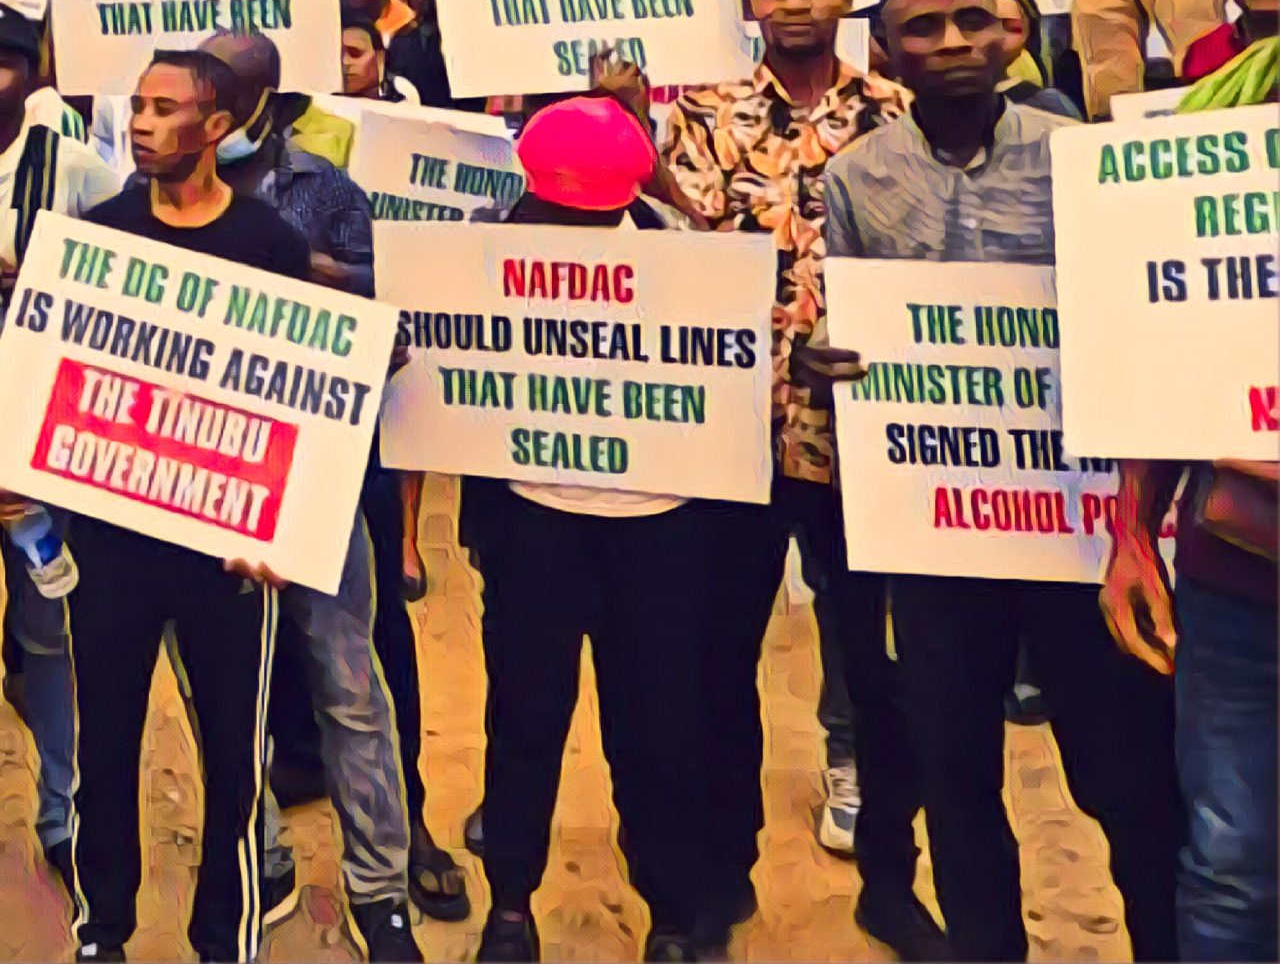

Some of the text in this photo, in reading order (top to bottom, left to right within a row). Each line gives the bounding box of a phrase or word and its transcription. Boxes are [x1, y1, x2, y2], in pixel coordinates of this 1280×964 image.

[97, 2, 152, 35] THAT
[161, 0, 221, 32] HAVE
[410, 152, 451, 189] THE
[1098, 130, 1250, 184] ACCESS
[1194, 192, 1280, 237] REG
[59, 238, 358, 357] THE DG OF NAFDAC
[503, 258, 634, 303] NAFDAC
[1147, 254, 1280, 303] IS THE
[397, 310, 756, 369] SHOULD UNSEAL LINES
[906, 302, 967, 344] THE
[15, 288, 372, 426] IS WORKING AGAINST
[438, 366, 706, 424] THAT HAVE BEEN
[1014, 367, 1051, 409] OF
[77, 367, 272, 464] THE TINUBU
[510, 428, 628, 474] SEALED
[886, 423, 1069, 472] SIGNED THE
[47, 425, 270, 532] GOVERNMENT
[934, 487, 1074, 534] ALCOHOL
